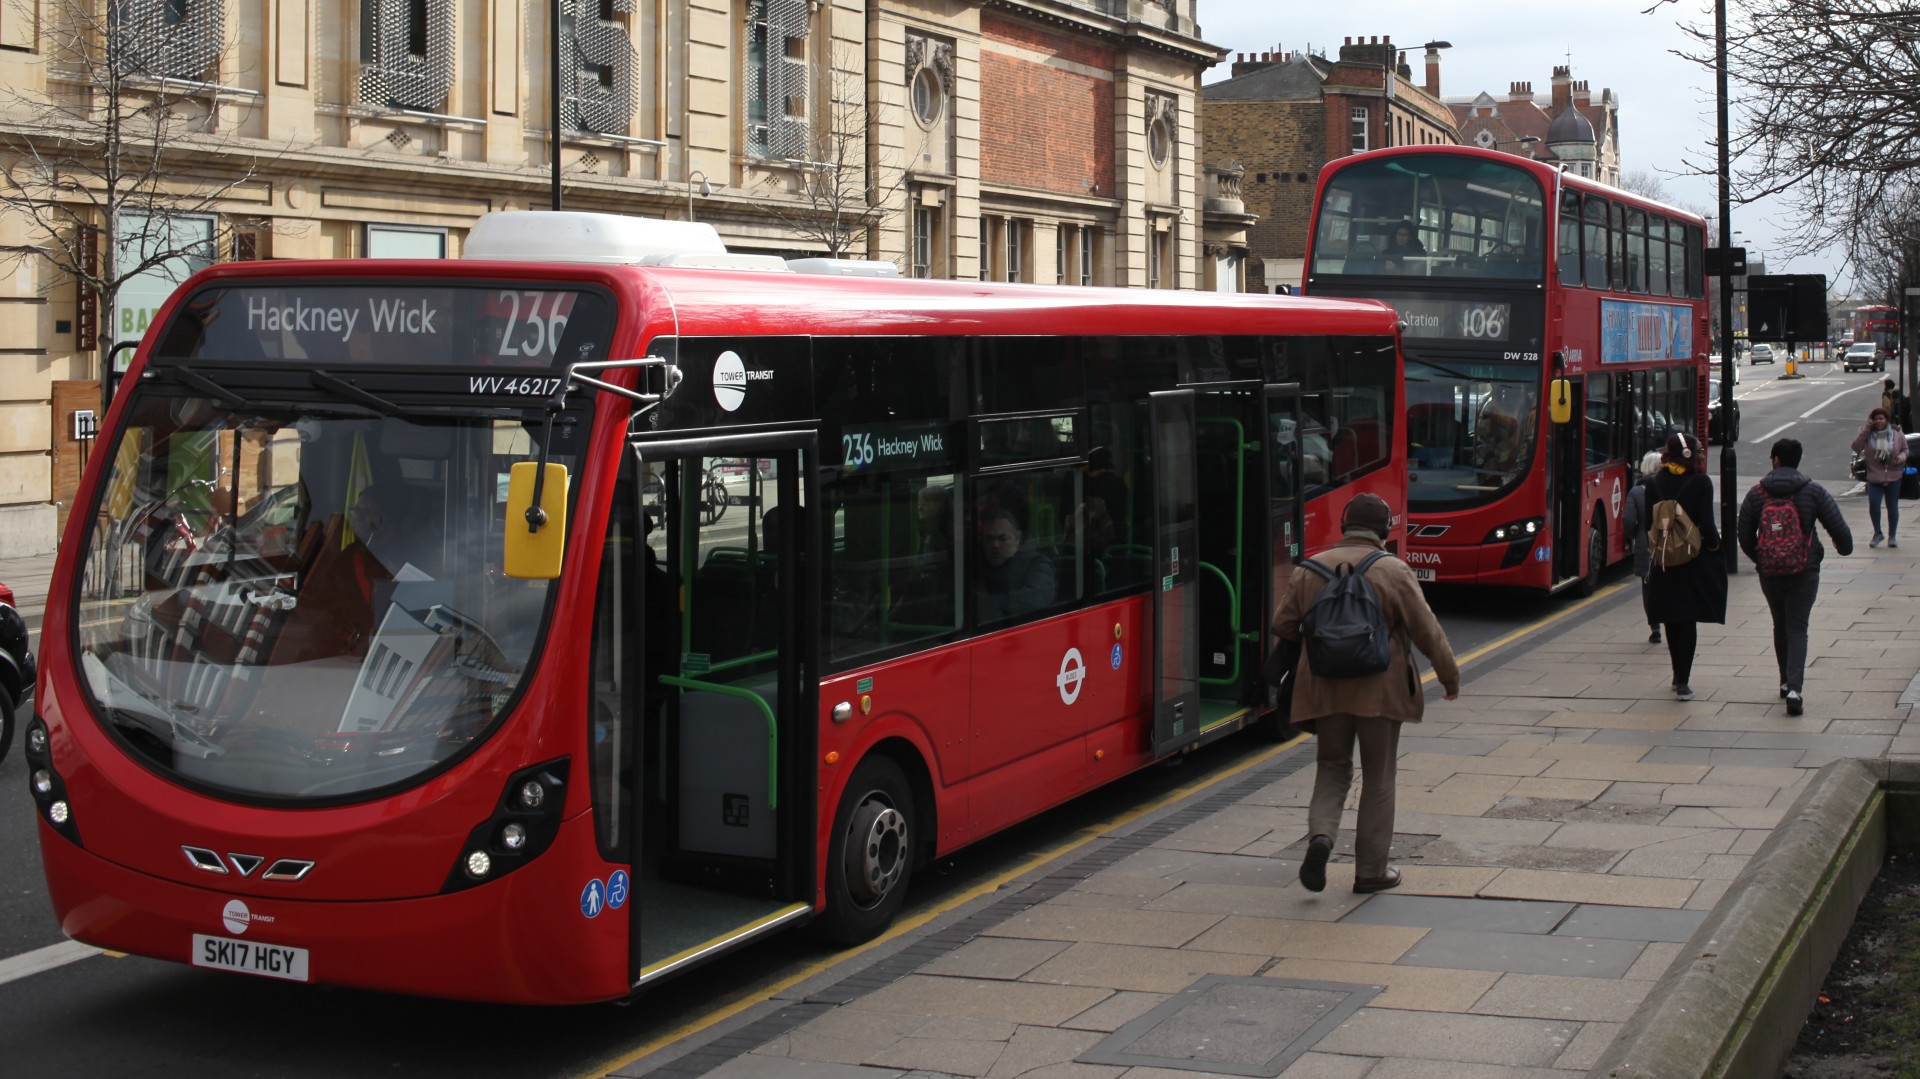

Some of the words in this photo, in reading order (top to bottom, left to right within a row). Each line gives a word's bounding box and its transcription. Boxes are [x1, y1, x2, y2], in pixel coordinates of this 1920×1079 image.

[121, 308, 159, 333] BA
[247, 296, 360, 342] Hackney
[369, 298, 437, 334] Wick
[498, 290, 569, 357] 236
[1404, 311, 1439, 327] Station
[1462, 308, 1502, 338] 106
[1504, 352, 1520, 360] DW
[720, 372, 744, 381] TOWER
[747, 370, 774, 380] TRANSIT
[843, 433, 873, 465] 236
[878, 437, 918, 457] Hackney
[921, 434, 943, 452] Wick
[1406, 552, 1441, 564] RRIVA
[1412, 569, 1429, 579] DU
[229, 911, 248, 919] TOWER
[251, 913, 275, 923] TRANSIT
[205, 939, 249, 967] SK17
[255, 947, 295, 974] HGY
